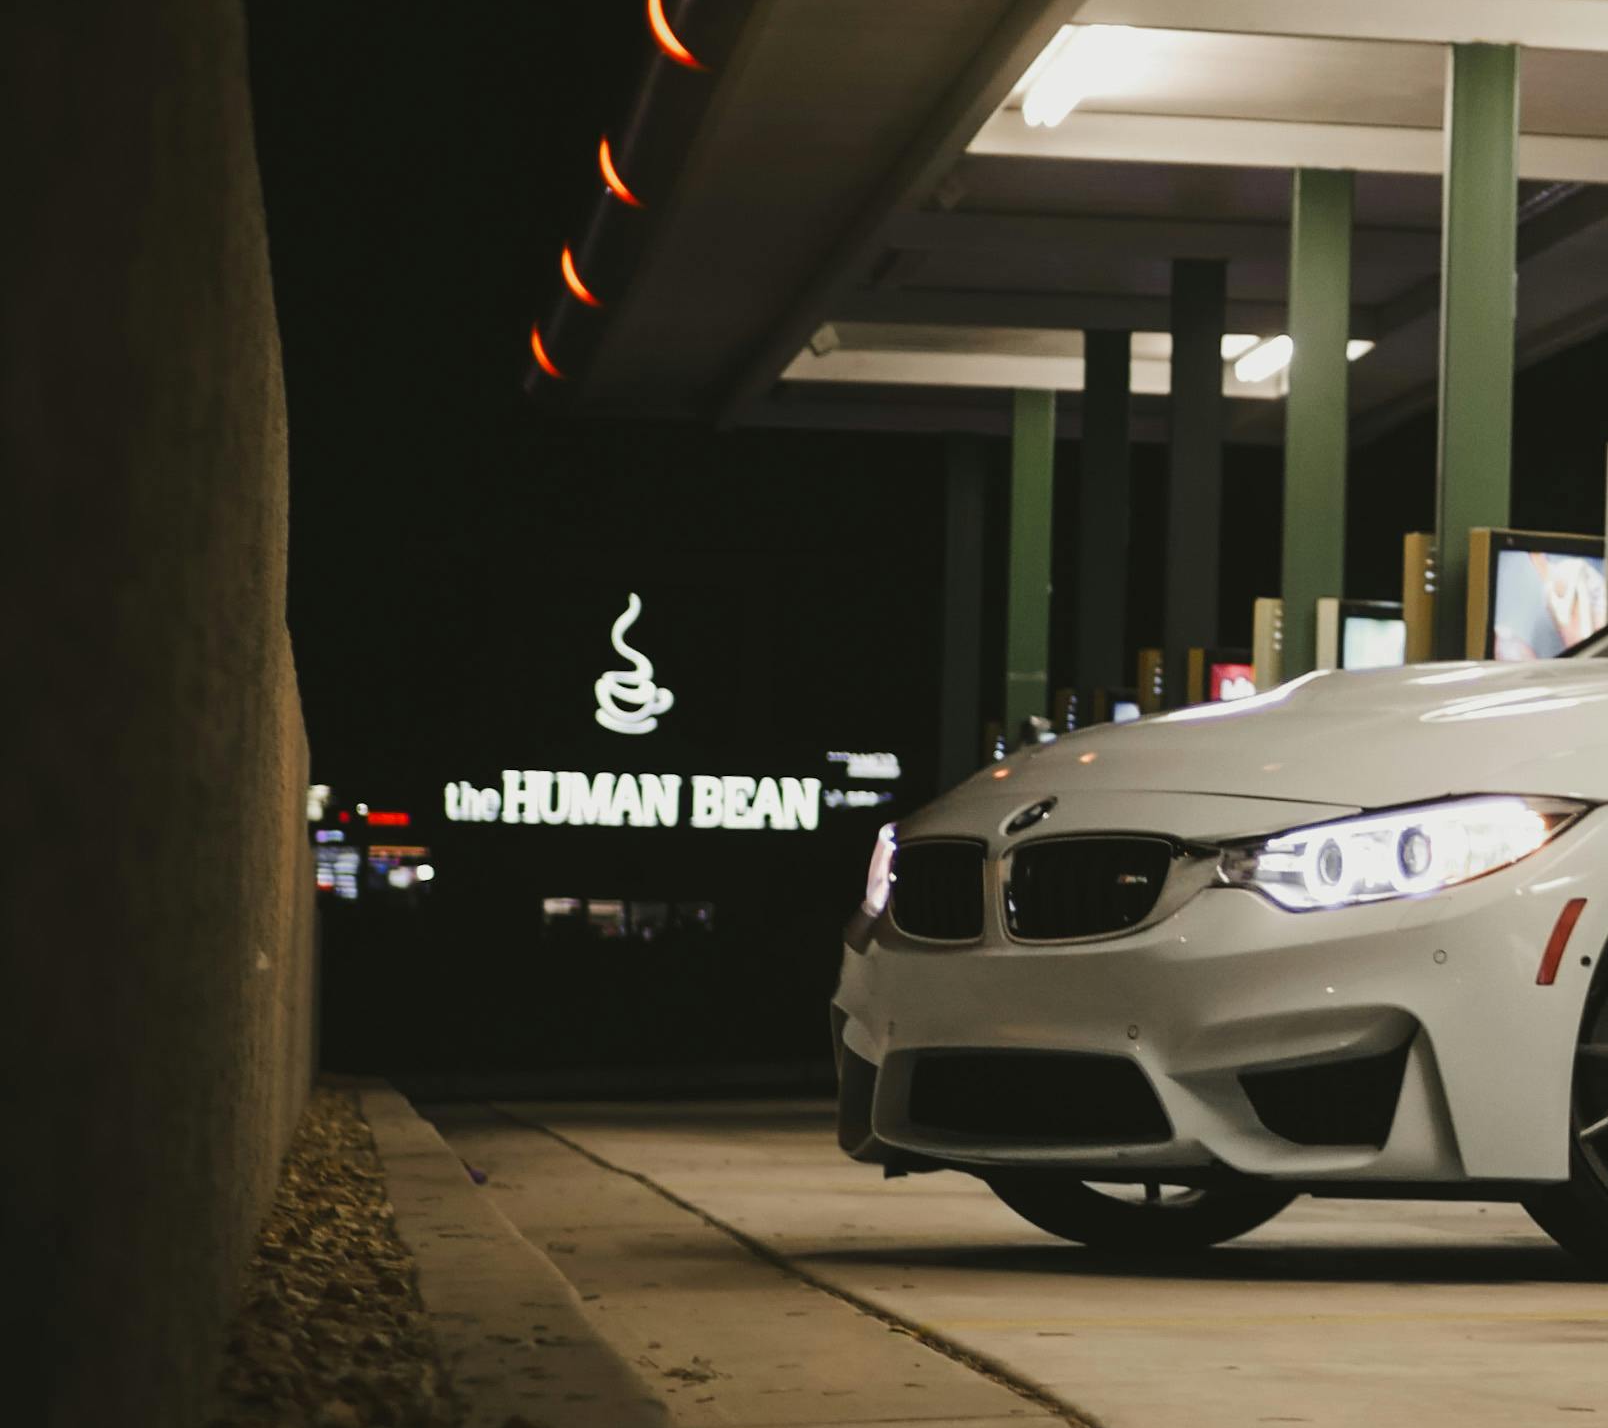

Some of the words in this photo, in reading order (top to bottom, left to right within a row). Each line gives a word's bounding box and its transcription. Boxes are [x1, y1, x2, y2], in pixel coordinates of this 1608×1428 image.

[444, 780, 500, 822] the
[502, 769, 682, 828] HUMAN
[690, 774, 822, 830] BEAN
